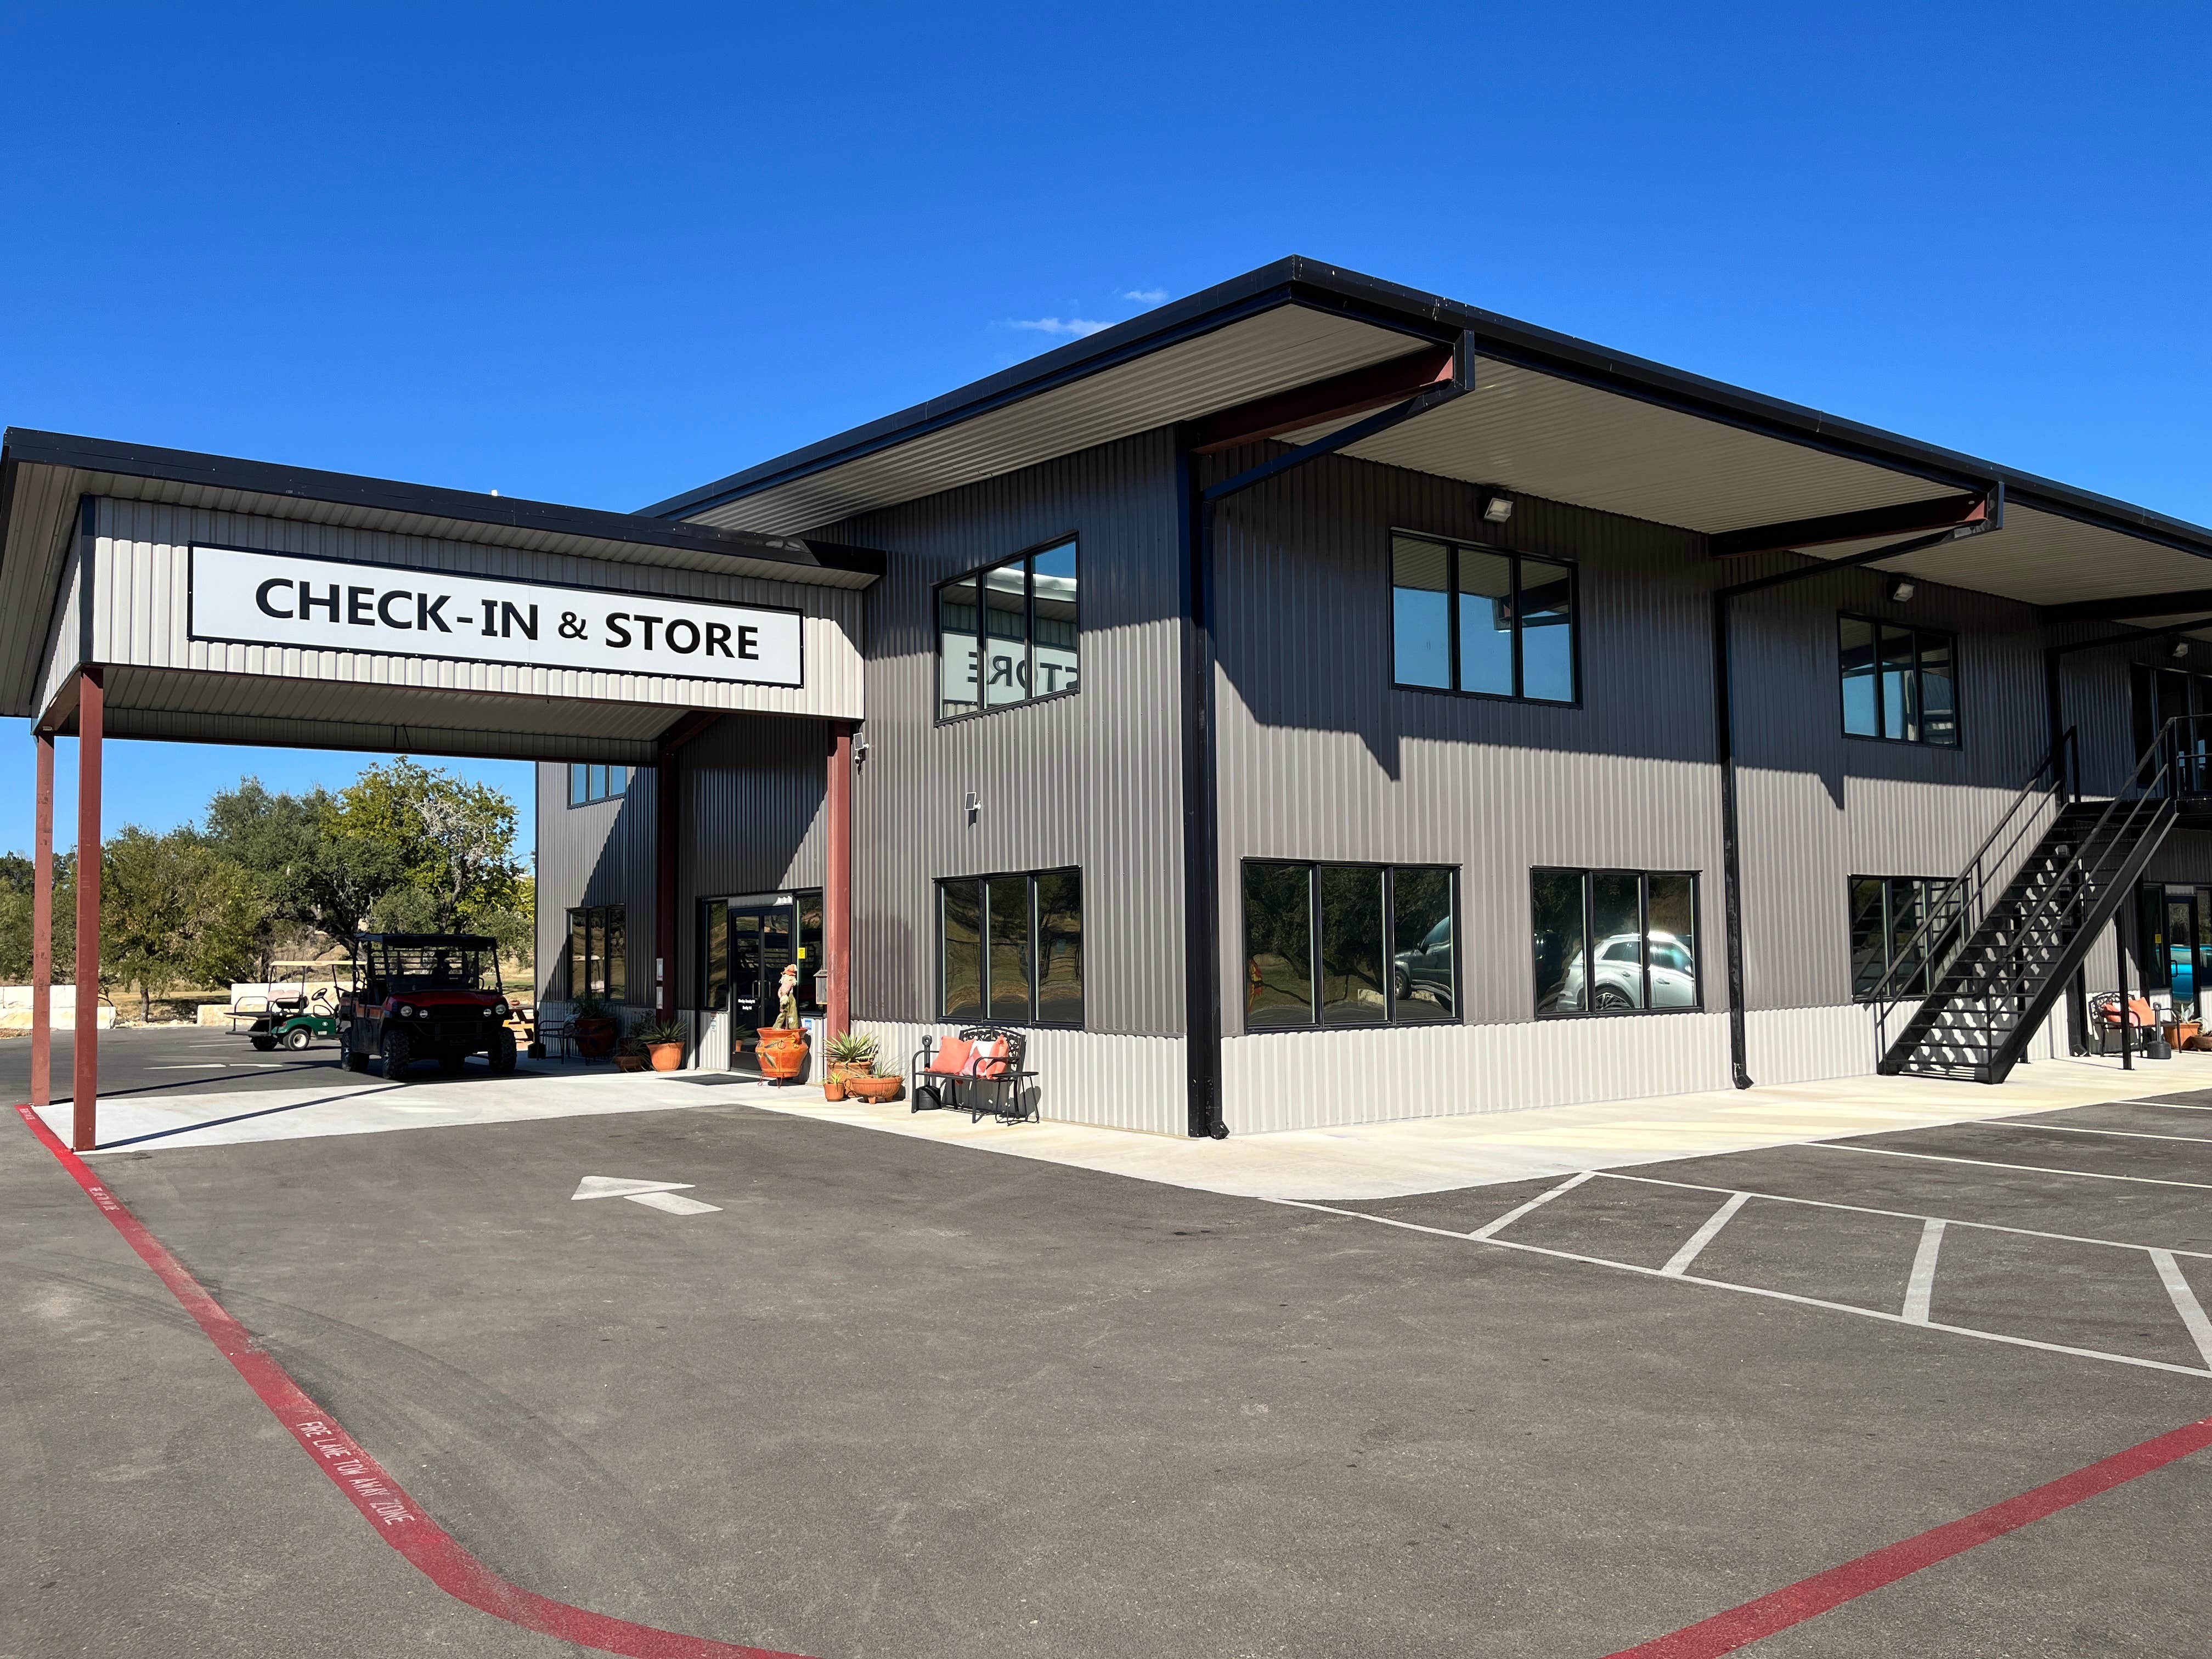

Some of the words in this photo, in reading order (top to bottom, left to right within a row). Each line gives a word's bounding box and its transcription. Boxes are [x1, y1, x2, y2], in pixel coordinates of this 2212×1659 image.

[255, 577, 539, 641] CHECK-IN
[558, 611, 589, 641] &
[605, 612, 759, 661] STORE
[297, 1421, 331, 1437] FIRE
[313, 1438, 351, 1458] LANE
[334, 1459, 369, 1476] TOW
[349, 1478, 390, 1497] AWAY
[369, 1502, 415, 1525] ZONE
